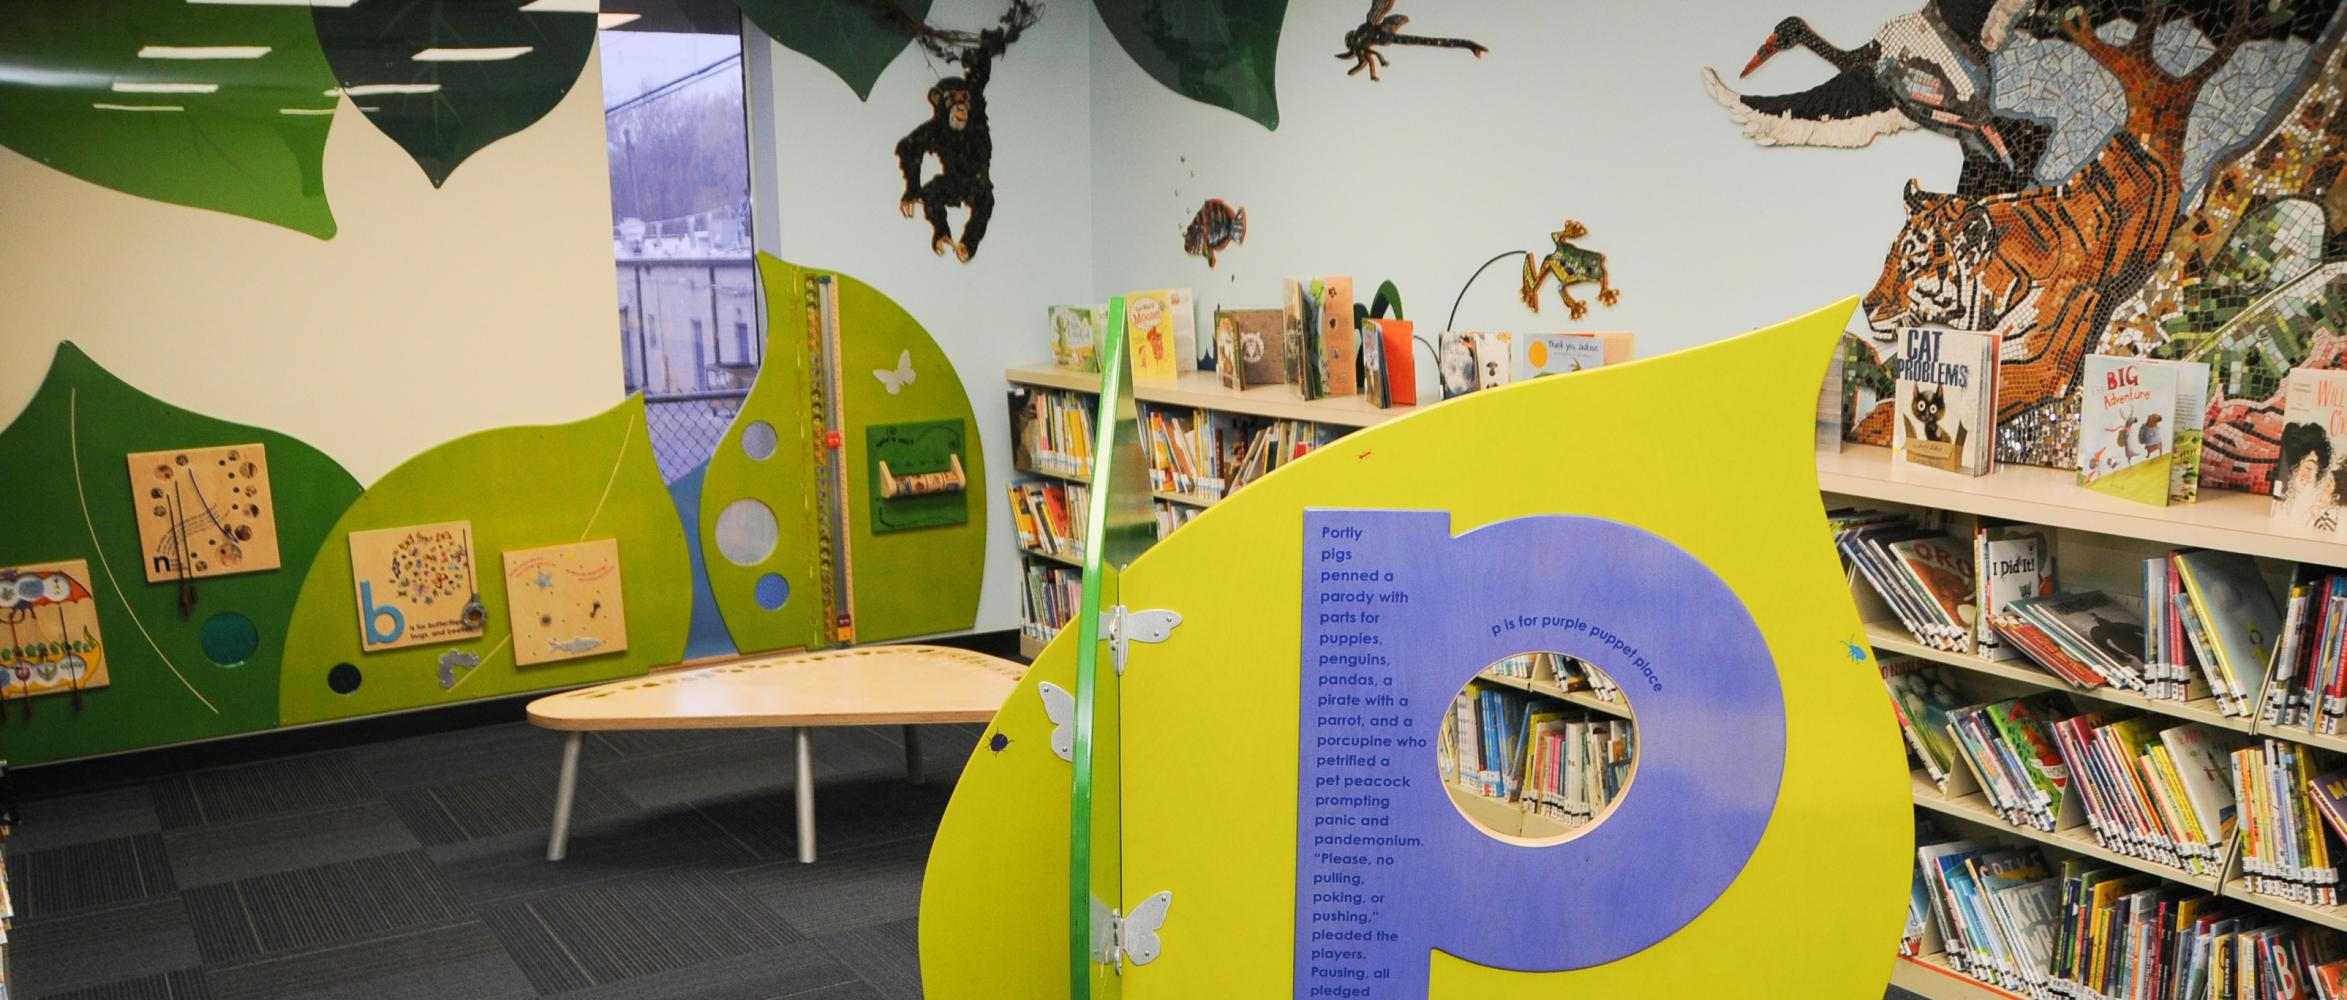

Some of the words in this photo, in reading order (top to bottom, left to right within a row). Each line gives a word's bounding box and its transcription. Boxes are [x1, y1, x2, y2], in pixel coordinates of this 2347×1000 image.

[1906, 328, 1943, 363] CAT
[1895, 358, 1969, 389] PROBLEMS
[2106, 365, 2139, 391] BIG
[2103, 387, 2152, 410] Adventure
[1321, 526, 1363, 542] Portly
[1321, 547, 1353, 563] pigs
[153, 555, 171, 574] n
[1993, 562, 1998, 576] I
[2000, 559, 2020, 578] Did
[2021, 558, 2035, 573] It!
[1320, 569, 1380, 584] penned
[1383, 572, 1394, 582] a
[1320, 590, 1375, 606] parody
[1378, 590, 1409, 603] with
[360, 580, 405, 645] b
[1319, 611, 1357, 626] parts
[1360, 611, 1381, 624] for
[1319, 632, 1383, 647] puppies,
[1319, 653, 1391, 668] penguins,
[1491, 624, 1501, 637] p
[1504, 619, 1515, 630] is
[1518, 615, 1538, 628] for
[1542, 616, 1587, 632] purple
[1589, 625, 1638, 659] puppet
[1632, 656, 1663, 693] place
[1318, 673, 1378, 687] pandas,
[1382, 676, 1393, 686] a
[1318, 694, 1361, 708] pirate
[1364, 694, 1394, 707] with
[1398, 697, 1409, 707] a
[1317, 714, 1365, 728] parrot,
[1369, 715, 1399, 727] and
[1402, 718, 1413, 728] a
[1317, 735, 1393, 749] porcupine
[1396, 735, 1427, 748] who
[1316, 754, 1376, 769] petrified
[1380, 757, 1390, 767] a
[1315, 774, 1340, 788] pet
[1344, 775, 1411, 789] peacock
[1315, 794, 1390, 810] prompting
[1314, 814, 1356, 828] panic
[1360, 815, 1389, 826] and
[1314, 833, 1425, 847] pandemonium.
[1376, 856, 1394, 865] no
[1313, 871, 1365, 887] pulling,
[1313, 891, 1366, 905] poking,
[1370, 894, 1385, 904] or
[1311, 929, 1373, 943] pleaded
[1376, 930, 1399, 942] the
[1311, 947, 1366, 961] players.
[1311, 966, 1369, 981] Pausing,
[1373, 968, 1390, 979] all
[1310, 984, 1370, 999] pledged
